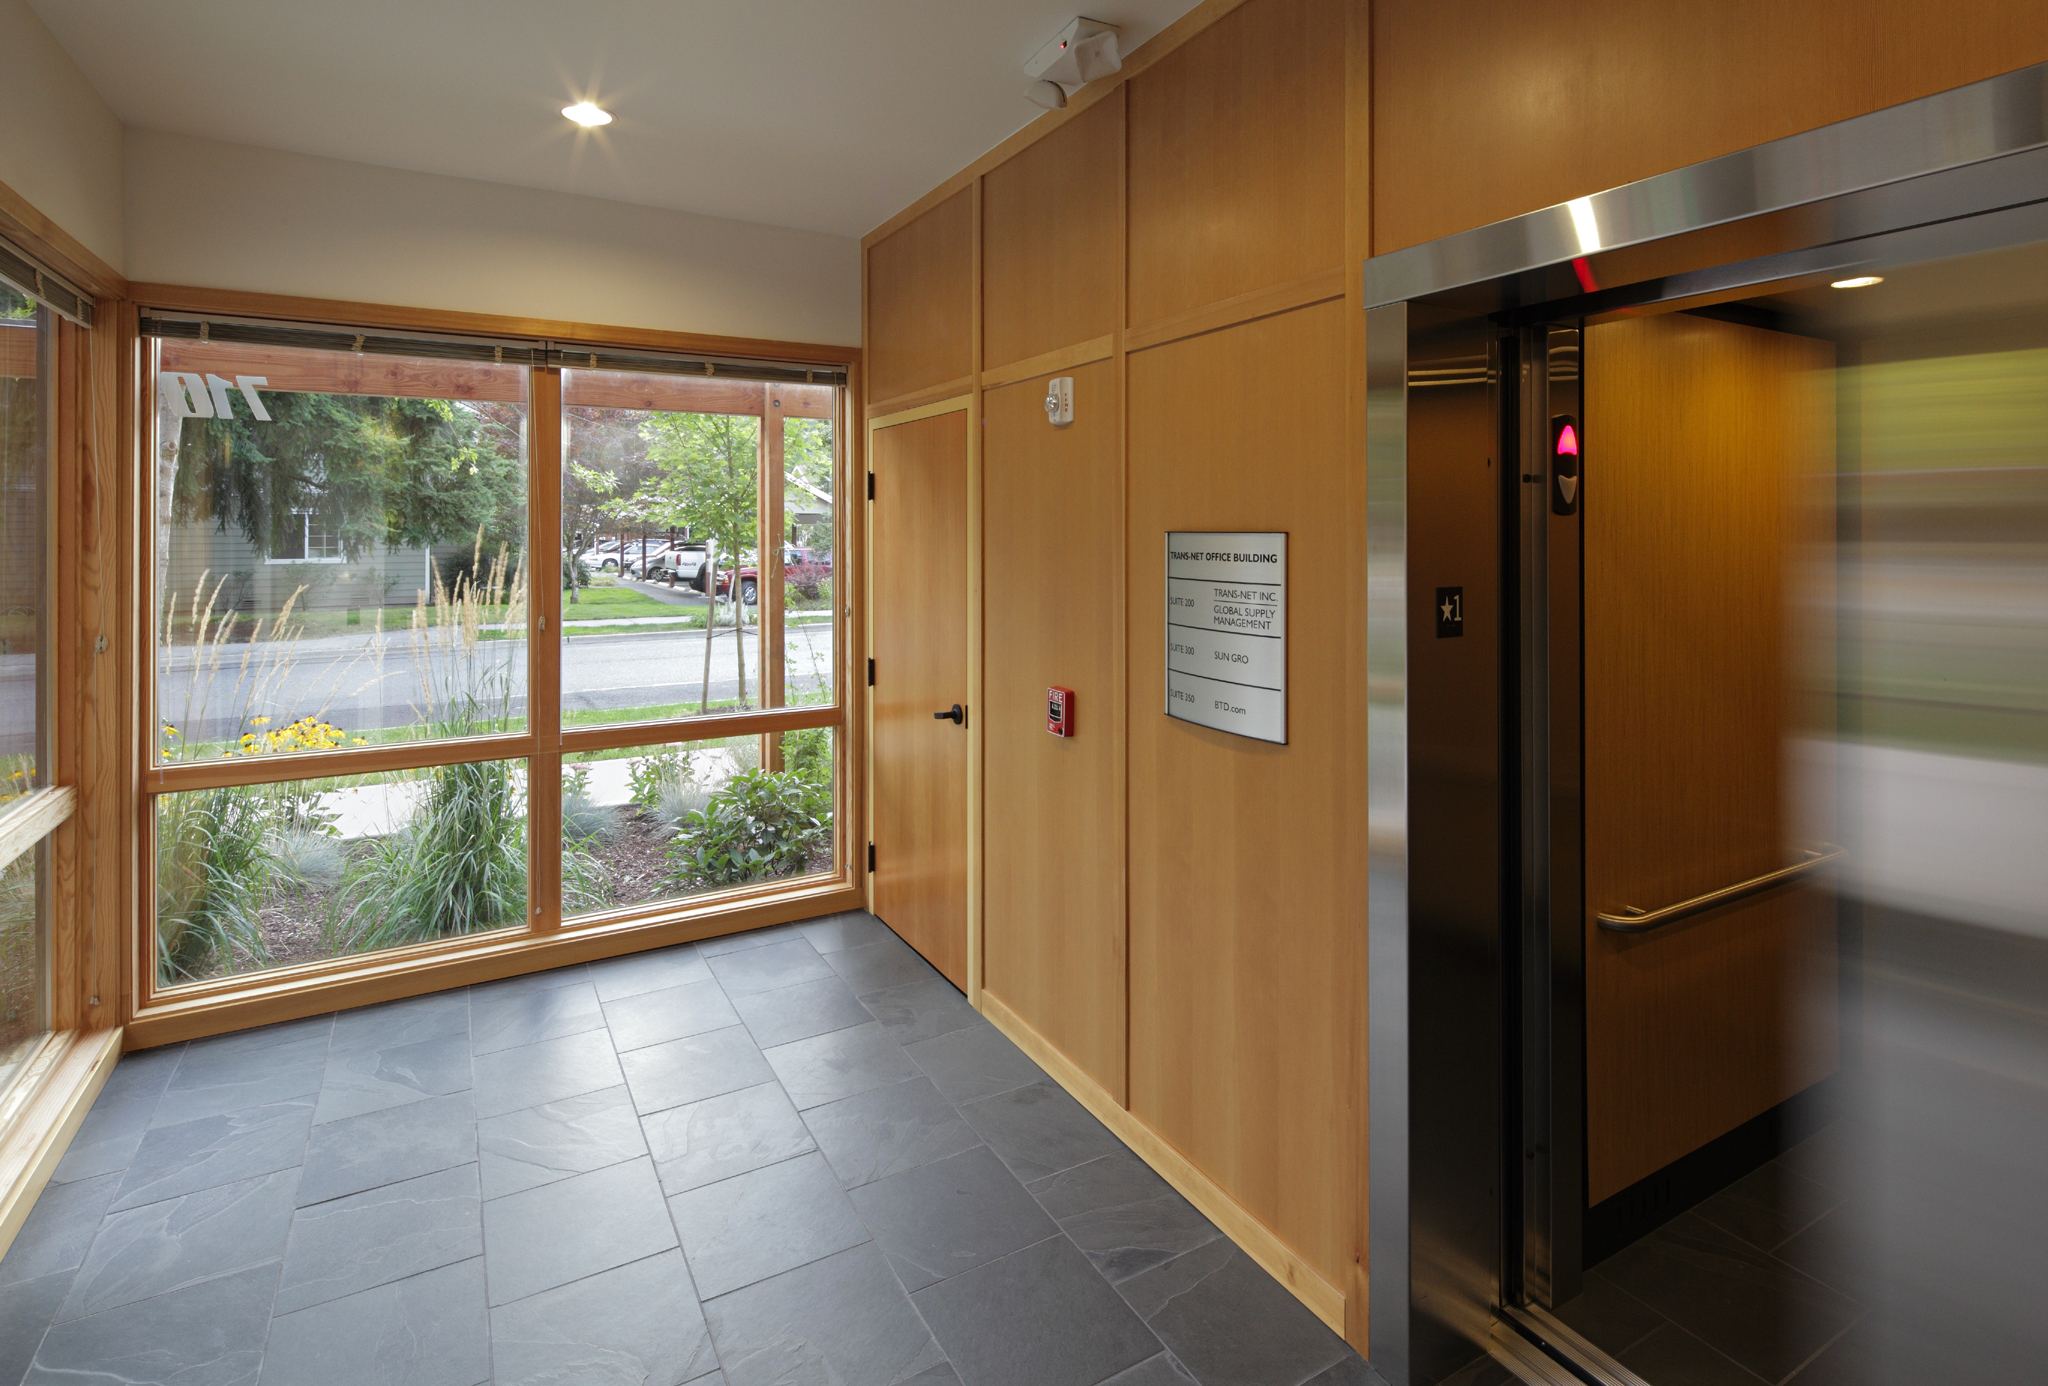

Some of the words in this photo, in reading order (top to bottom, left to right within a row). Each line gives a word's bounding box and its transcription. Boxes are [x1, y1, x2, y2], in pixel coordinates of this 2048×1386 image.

[1170, 551, 1204, 561] TRANS-NET
[1205, 552, 1231, 562] OFFICE
[1233, 553, 1278, 563] BUILDING
[1170, 596, 1184, 607] SUITE
[1185, 598, 1195, 608] 200
[1214, 588, 1257, 600] TRANS-NET
[1259, 591, 1278, 602] INC.
[1213, 604, 1243, 616] GLOBAL
[1244, 607, 1276, 619] SUPPLY
[1453, 594, 1462, 622] 1
[1213, 615, 1271, 630] MANAGEMENT
[1170, 642, 1184, 654] SUITE
[1185, 645, 1195, 656] 300
[1214, 650, 1230, 662] SUN
[1231, 653, 1249, 665] GRO
[1049, 690, 1063, 704] FIRE
[1169, 688, 1184, 701] SUITE
[1185, 692, 1195, 704] 350
[1214, 700, 1246, 715] BTD.com
